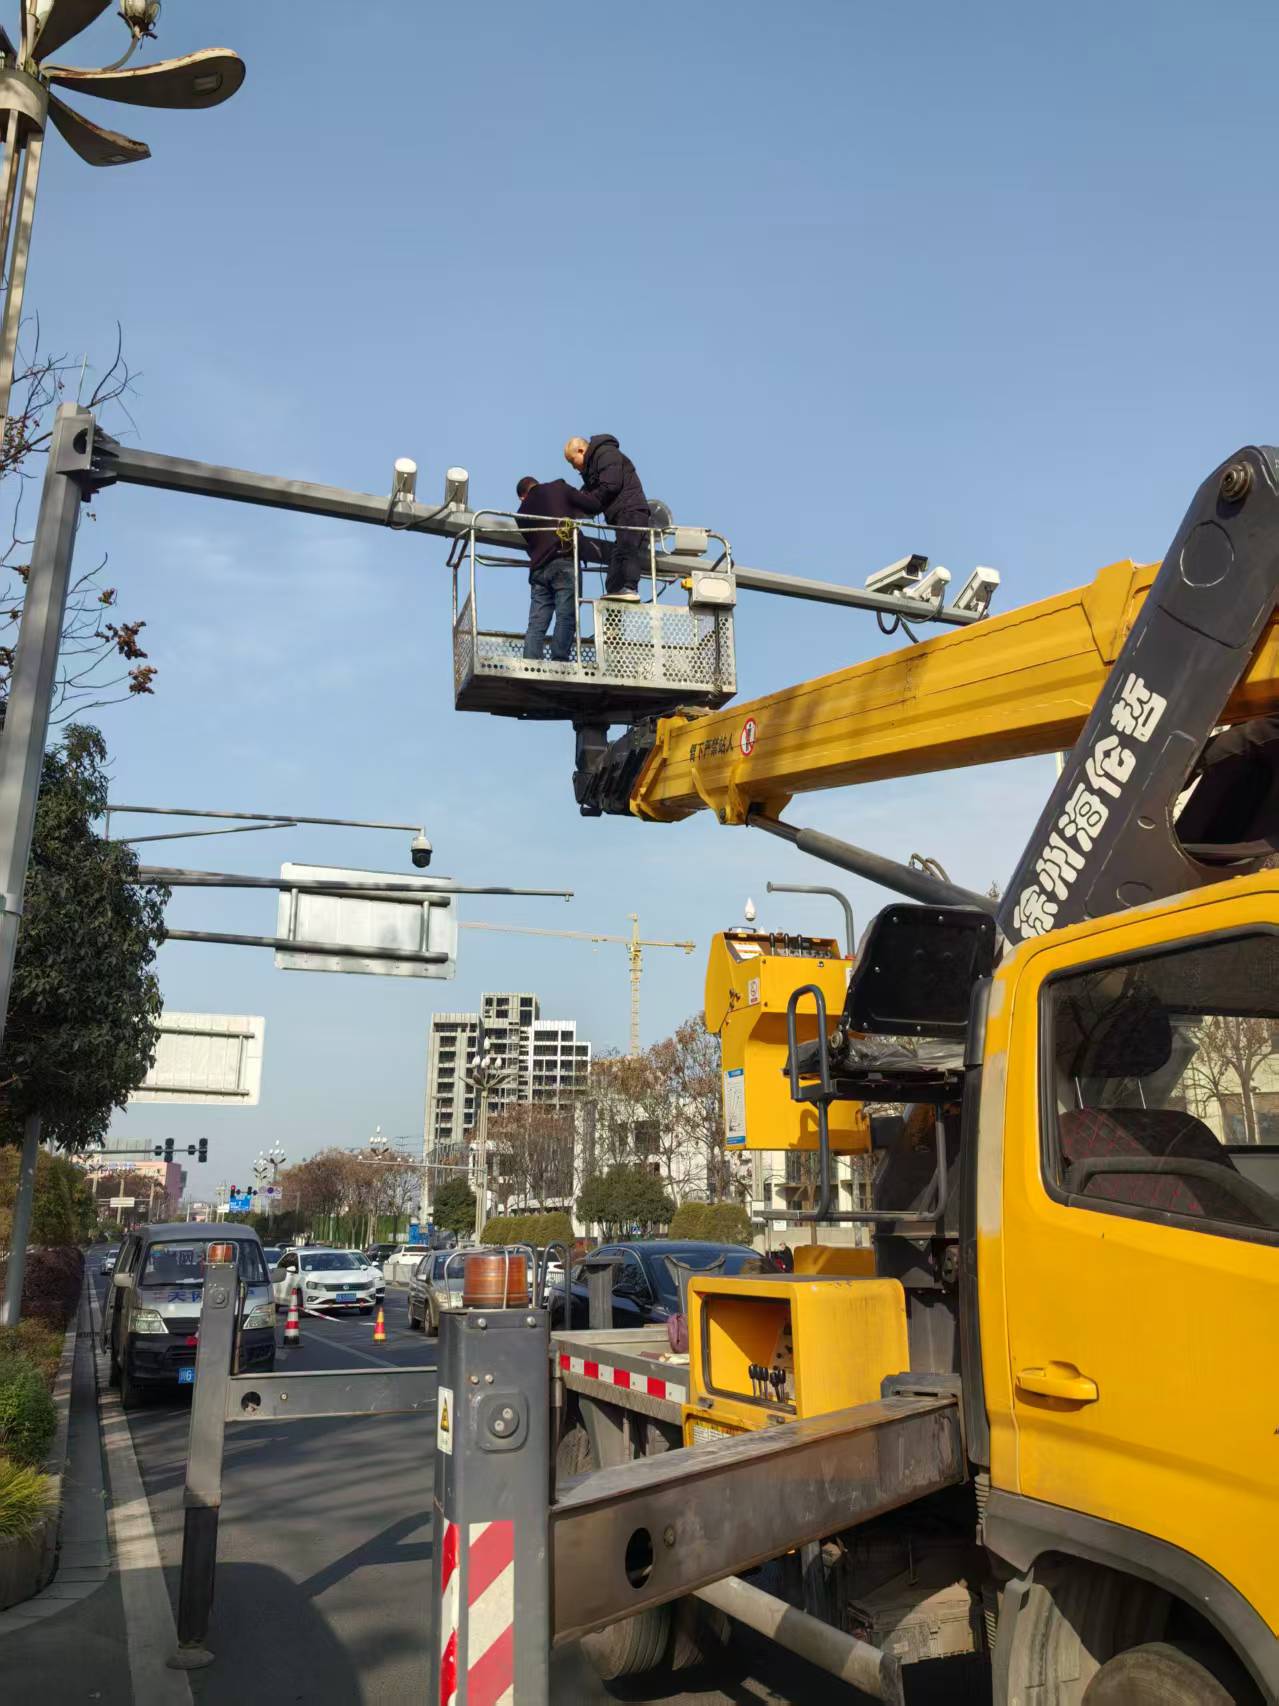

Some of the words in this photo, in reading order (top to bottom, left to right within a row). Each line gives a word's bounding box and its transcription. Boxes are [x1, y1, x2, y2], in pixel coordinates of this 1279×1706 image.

[1013, 672, 1168, 939] 徐州海伦哲
